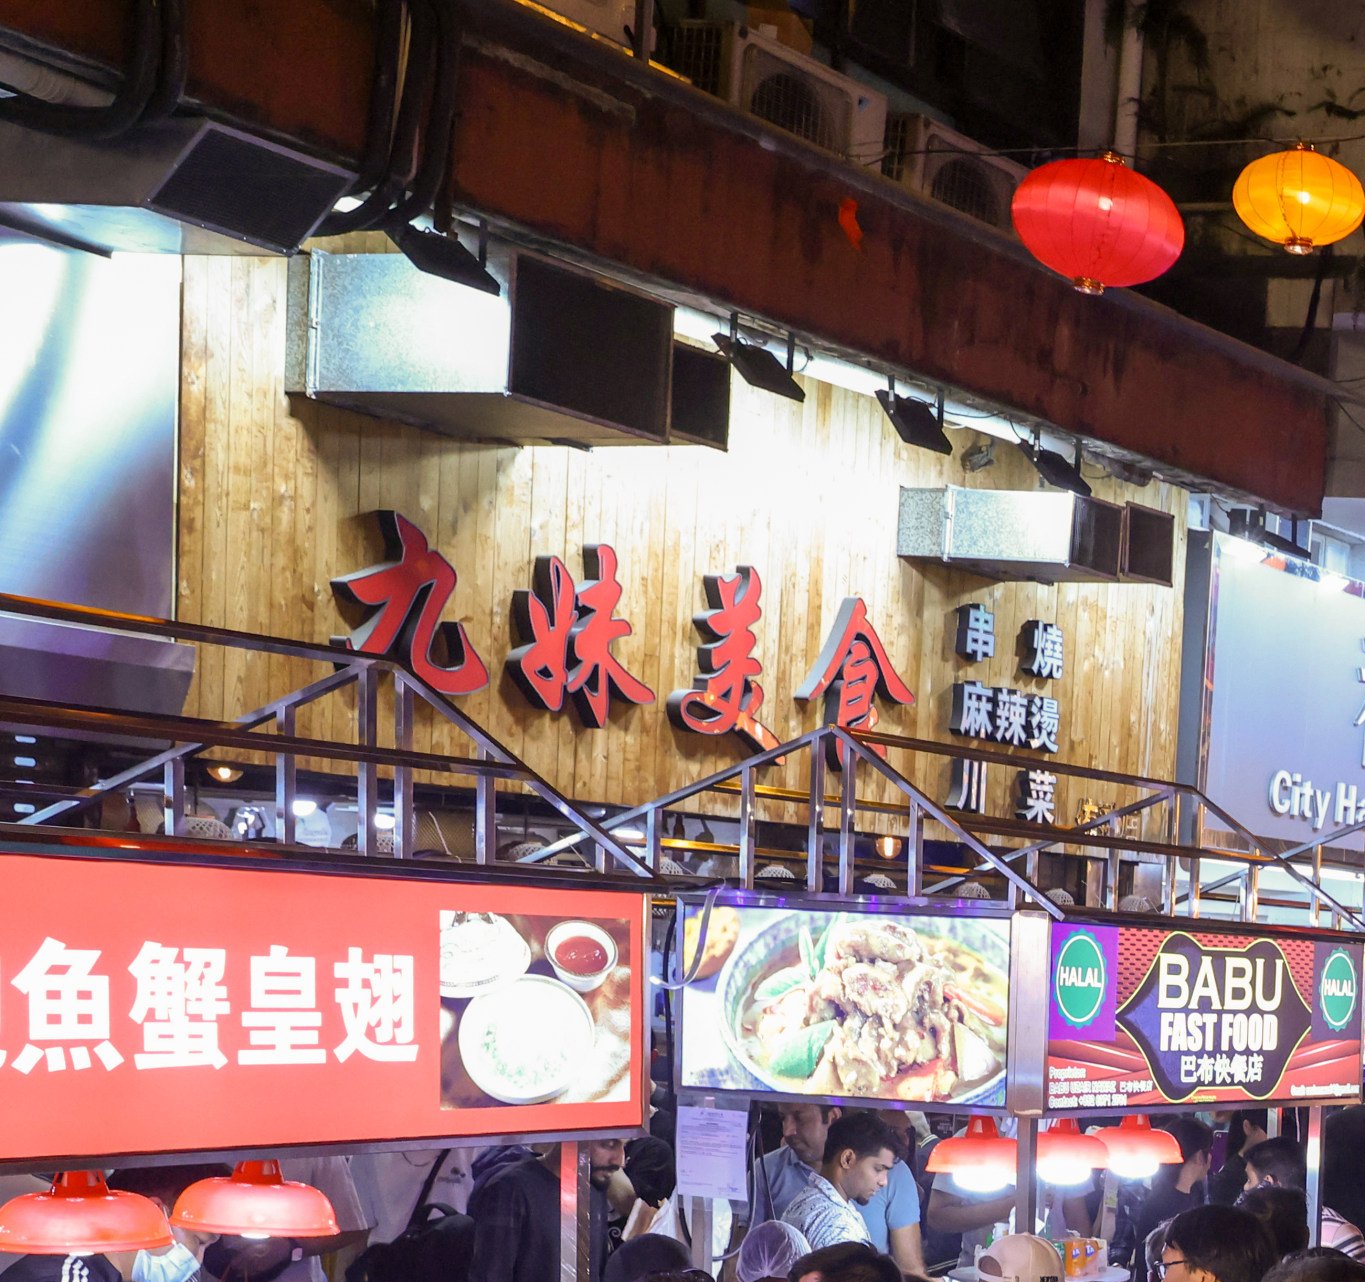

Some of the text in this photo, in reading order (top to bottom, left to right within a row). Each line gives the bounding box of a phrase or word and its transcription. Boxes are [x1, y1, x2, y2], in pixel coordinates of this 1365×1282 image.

[950, 681, 1060, 754] 麻辣燙
[1268, 768, 1332, 831] City
[1059, 966, 1102, 988] HALAL
[1157, 952, 1286, 1012] BABU
[1324, 978, 1354, 998] HALAL
[0, 936, 420, 1074] 魚蟹皇翅
[1159, 1012, 1278, 1051] FAST FOOD
[1180, 1053, 1264, 1085] 巴布快餐店
